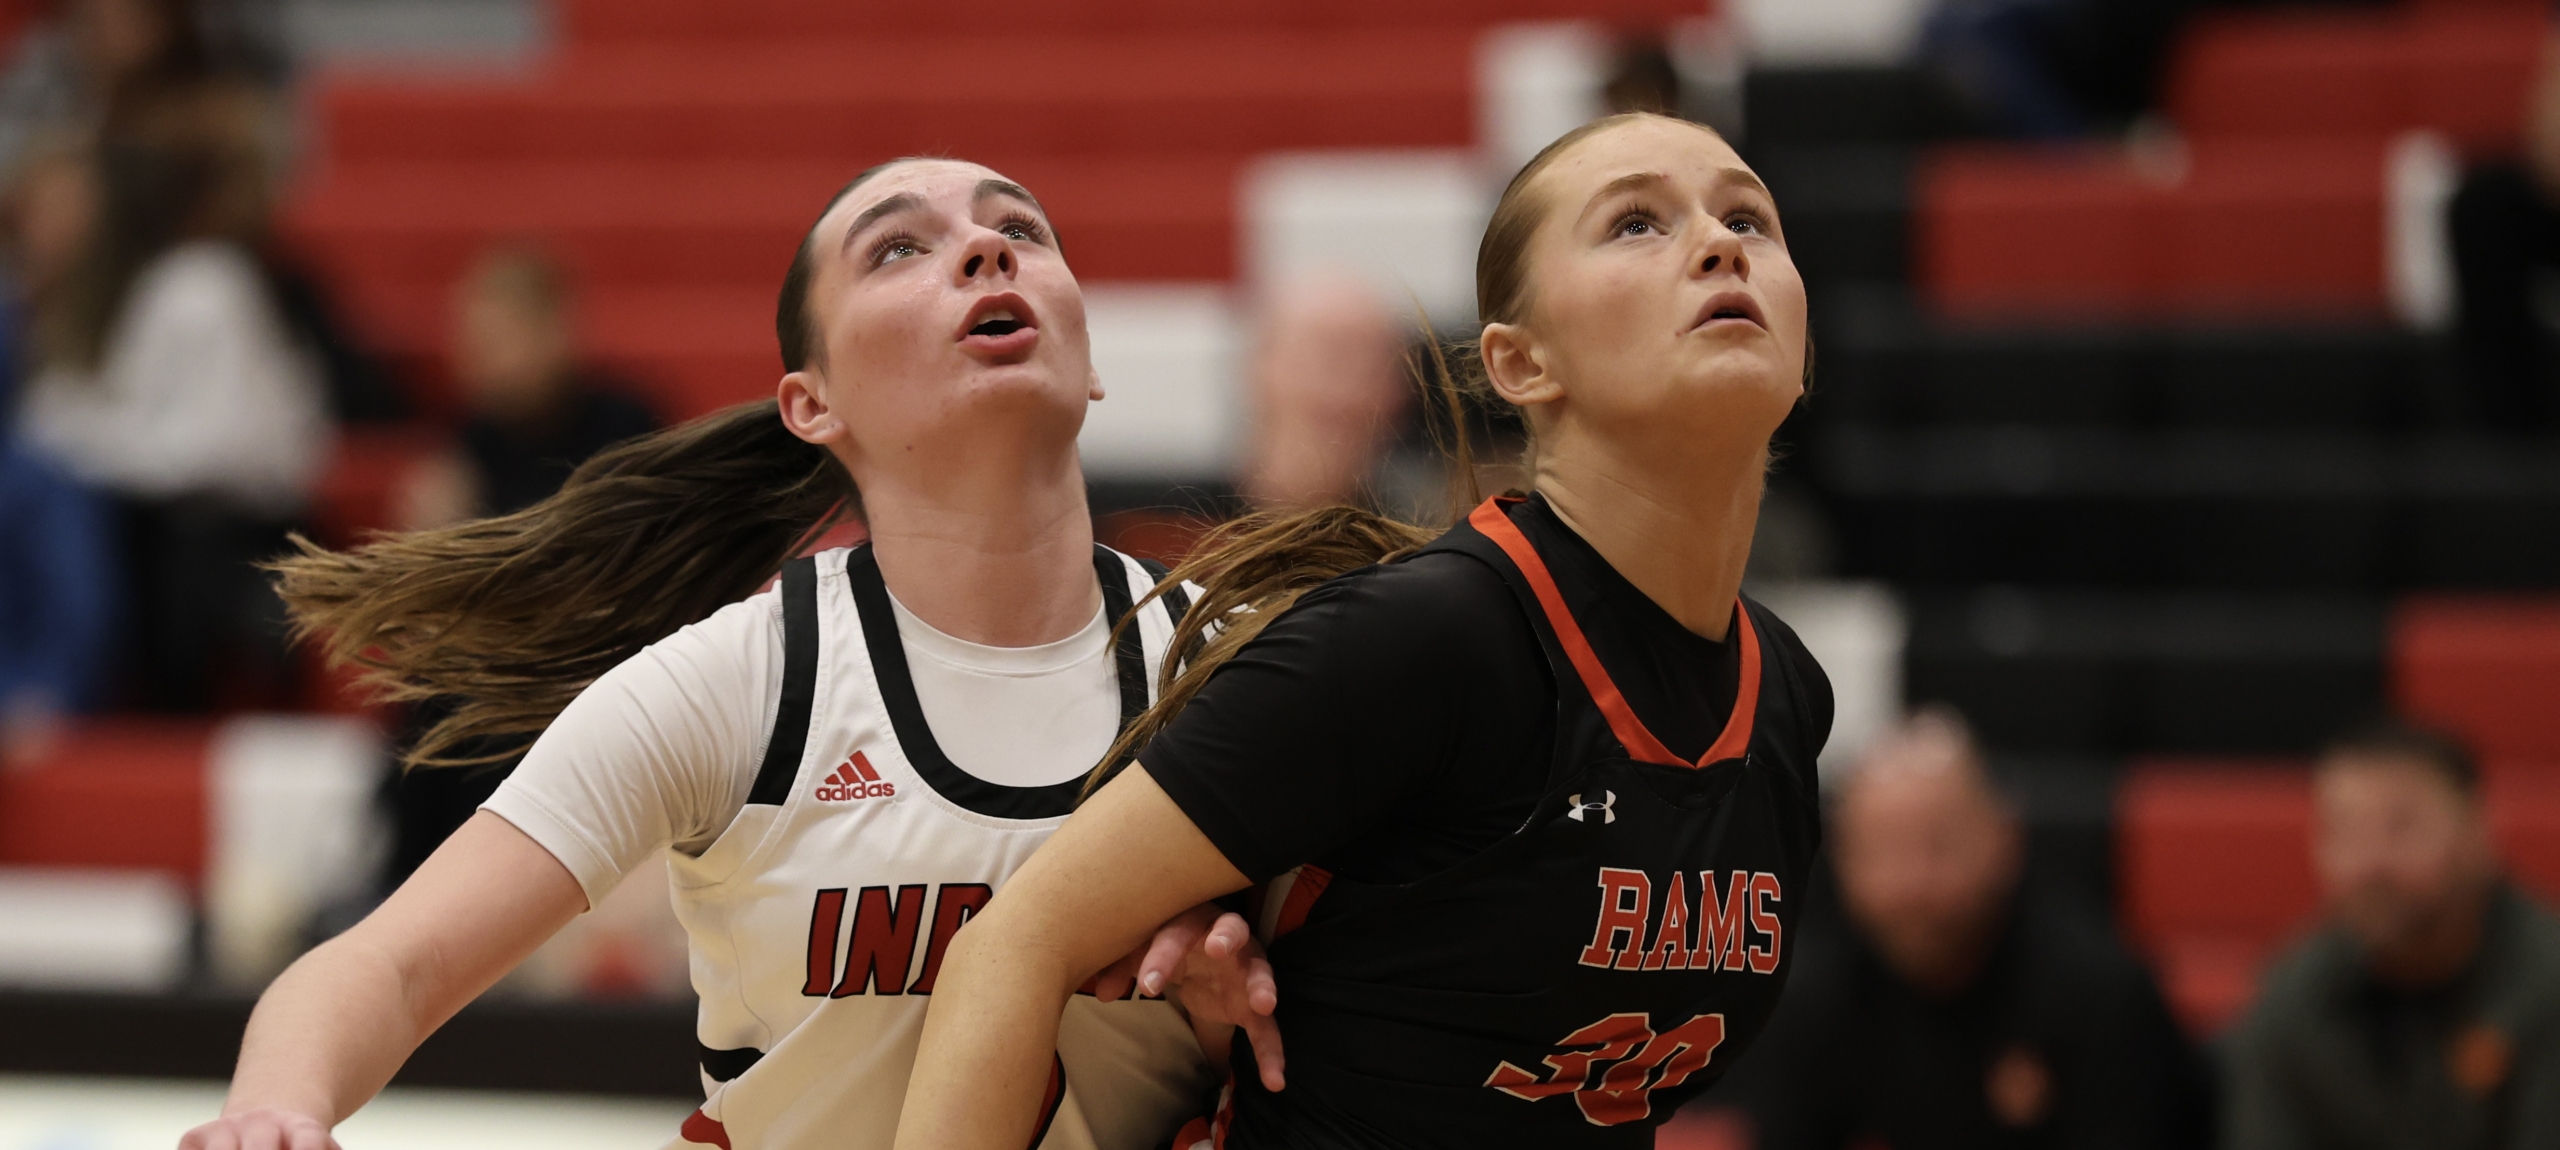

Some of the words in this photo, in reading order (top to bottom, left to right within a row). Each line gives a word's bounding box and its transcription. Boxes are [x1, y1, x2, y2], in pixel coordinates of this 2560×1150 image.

[815, 781, 895, 801] adidas
[1578, 867, 1781, 974] RAMS
[1483, 1012, 1725, 1126] 30
